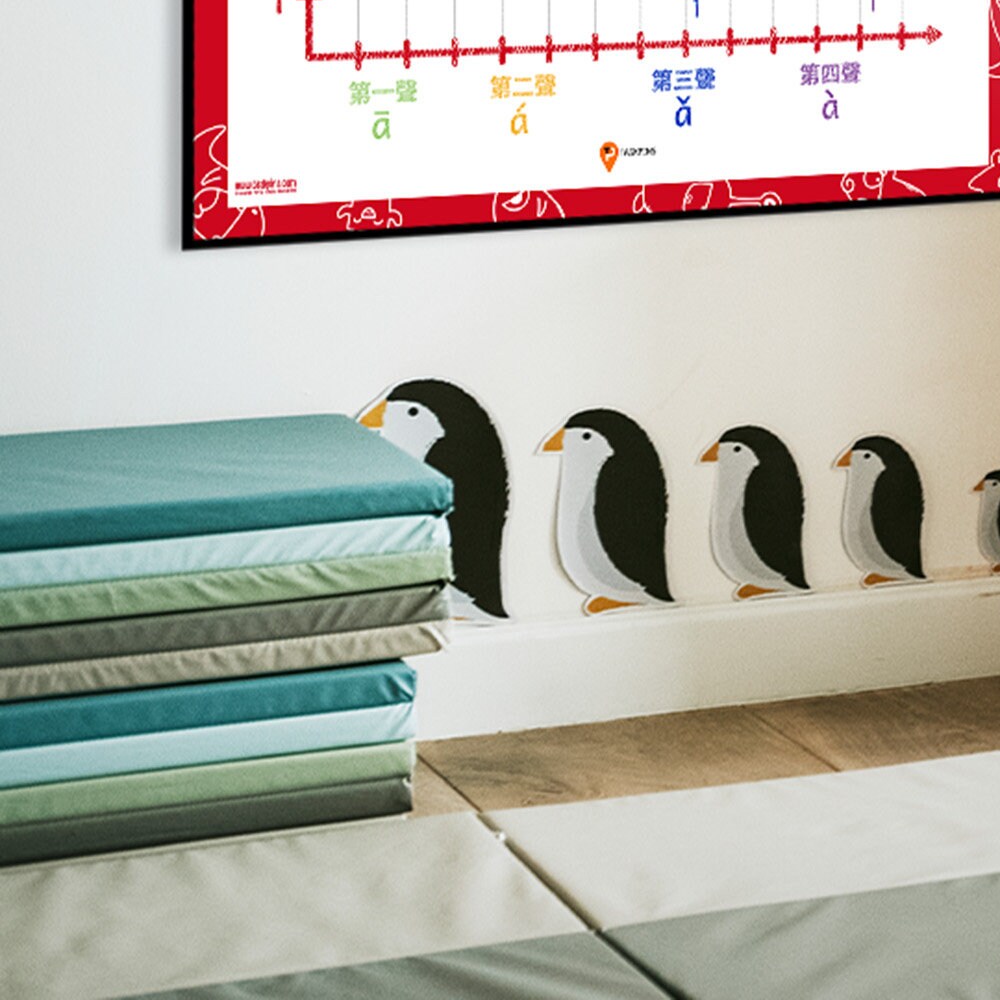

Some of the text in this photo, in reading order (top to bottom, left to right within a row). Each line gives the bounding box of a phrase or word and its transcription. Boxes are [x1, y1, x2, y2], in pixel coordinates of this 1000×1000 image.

[490, 73, 557, 100] 第二聲
[651, 67, 716, 92] 第三聲
[800, 61, 862, 86] 第四聲
[349, 79, 418, 106] 第一聲
